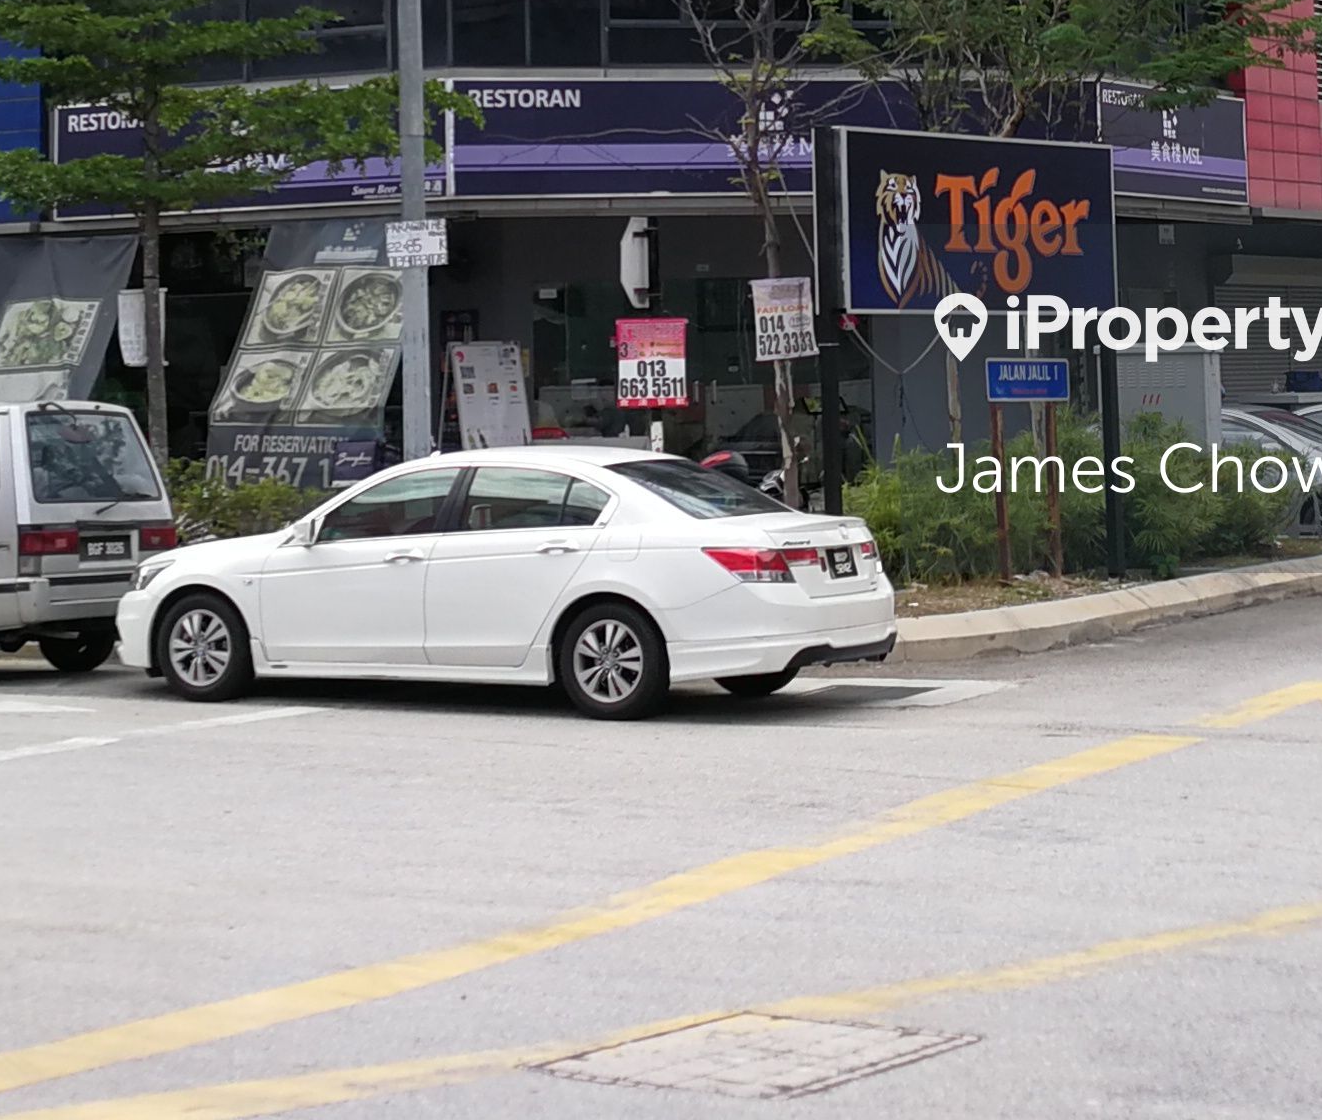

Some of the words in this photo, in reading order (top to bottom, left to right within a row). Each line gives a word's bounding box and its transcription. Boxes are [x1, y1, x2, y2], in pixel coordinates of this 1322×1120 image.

[468, 88, 581, 109] RESTORAN
[67, 110, 145, 133] RESTO
[1150, 140, 1182, 163] 美食楼
[1182, 146, 1203, 165] MSL
[934, 167, 1090, 294] Tiger
[759, 315, 785, 334] 014
[759, 334, 782, 356] 522
[783, 331, 814, 354] 3333
[637, 360, 667, 377] 013
[998, 364, 1026, 381] JALAN
[1027, 364, 1052, 381] JALIL
[620, 378, 648, 398] 663
[652, 377, 684, 397] 5511
[233, 434, 259, 452] FOR
[261, 434, 349, 454] RESERVATI
